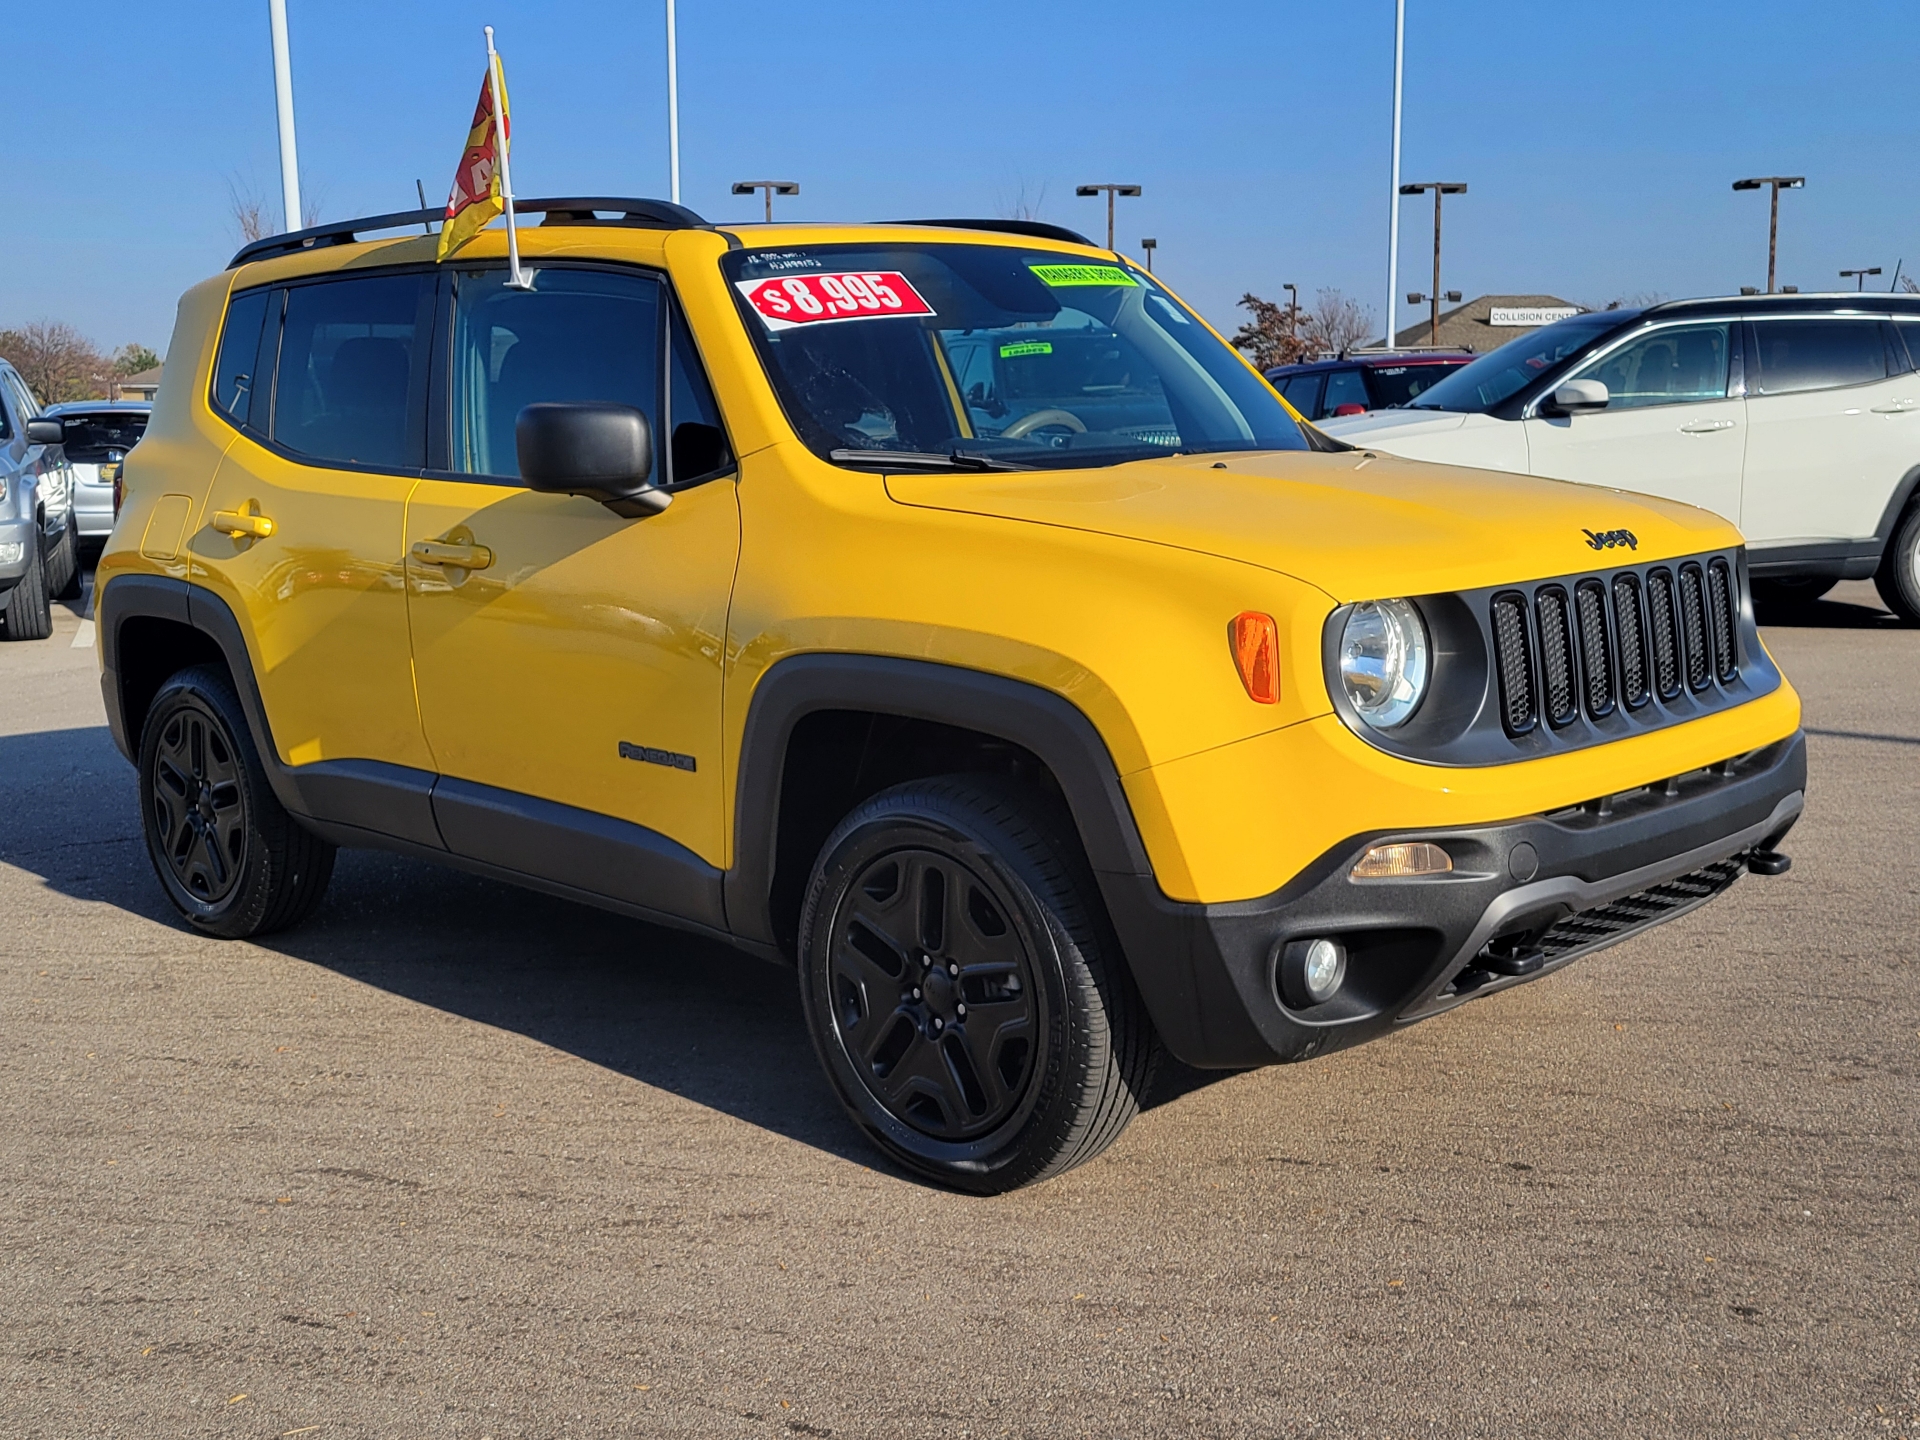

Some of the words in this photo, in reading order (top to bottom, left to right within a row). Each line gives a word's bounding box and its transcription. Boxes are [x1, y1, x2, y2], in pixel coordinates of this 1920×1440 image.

[762, 274, 902, 315] $8,995
[1493, 312, 1542, 321] COLLISION
[1581, 528, 1638, 551] Jeep
[618, 741, 697, 773] RENEGADE
